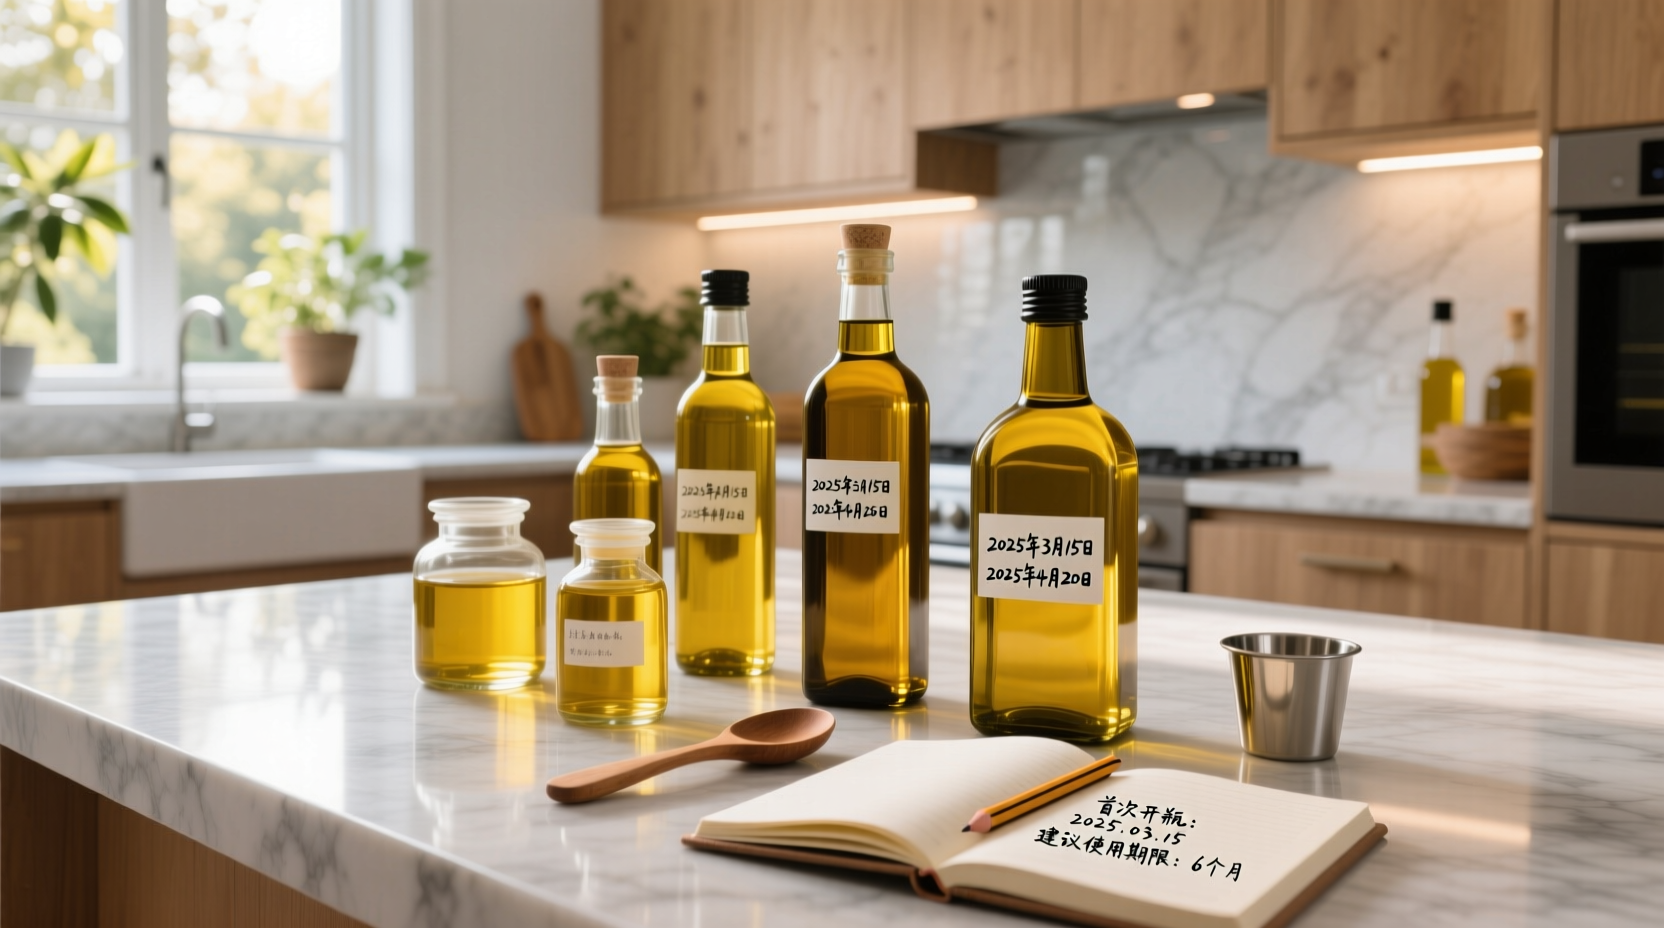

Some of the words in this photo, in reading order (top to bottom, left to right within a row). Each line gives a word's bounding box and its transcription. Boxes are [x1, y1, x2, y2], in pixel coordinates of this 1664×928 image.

[986, 532, 1093, 559] 2025年3月15日
[986, 562, 1092, 589] 2025年4月20日
[1097, 795, 1197, 828] 首次开瓶：
[1070, 813, 1187, 845] 2025.03.15
